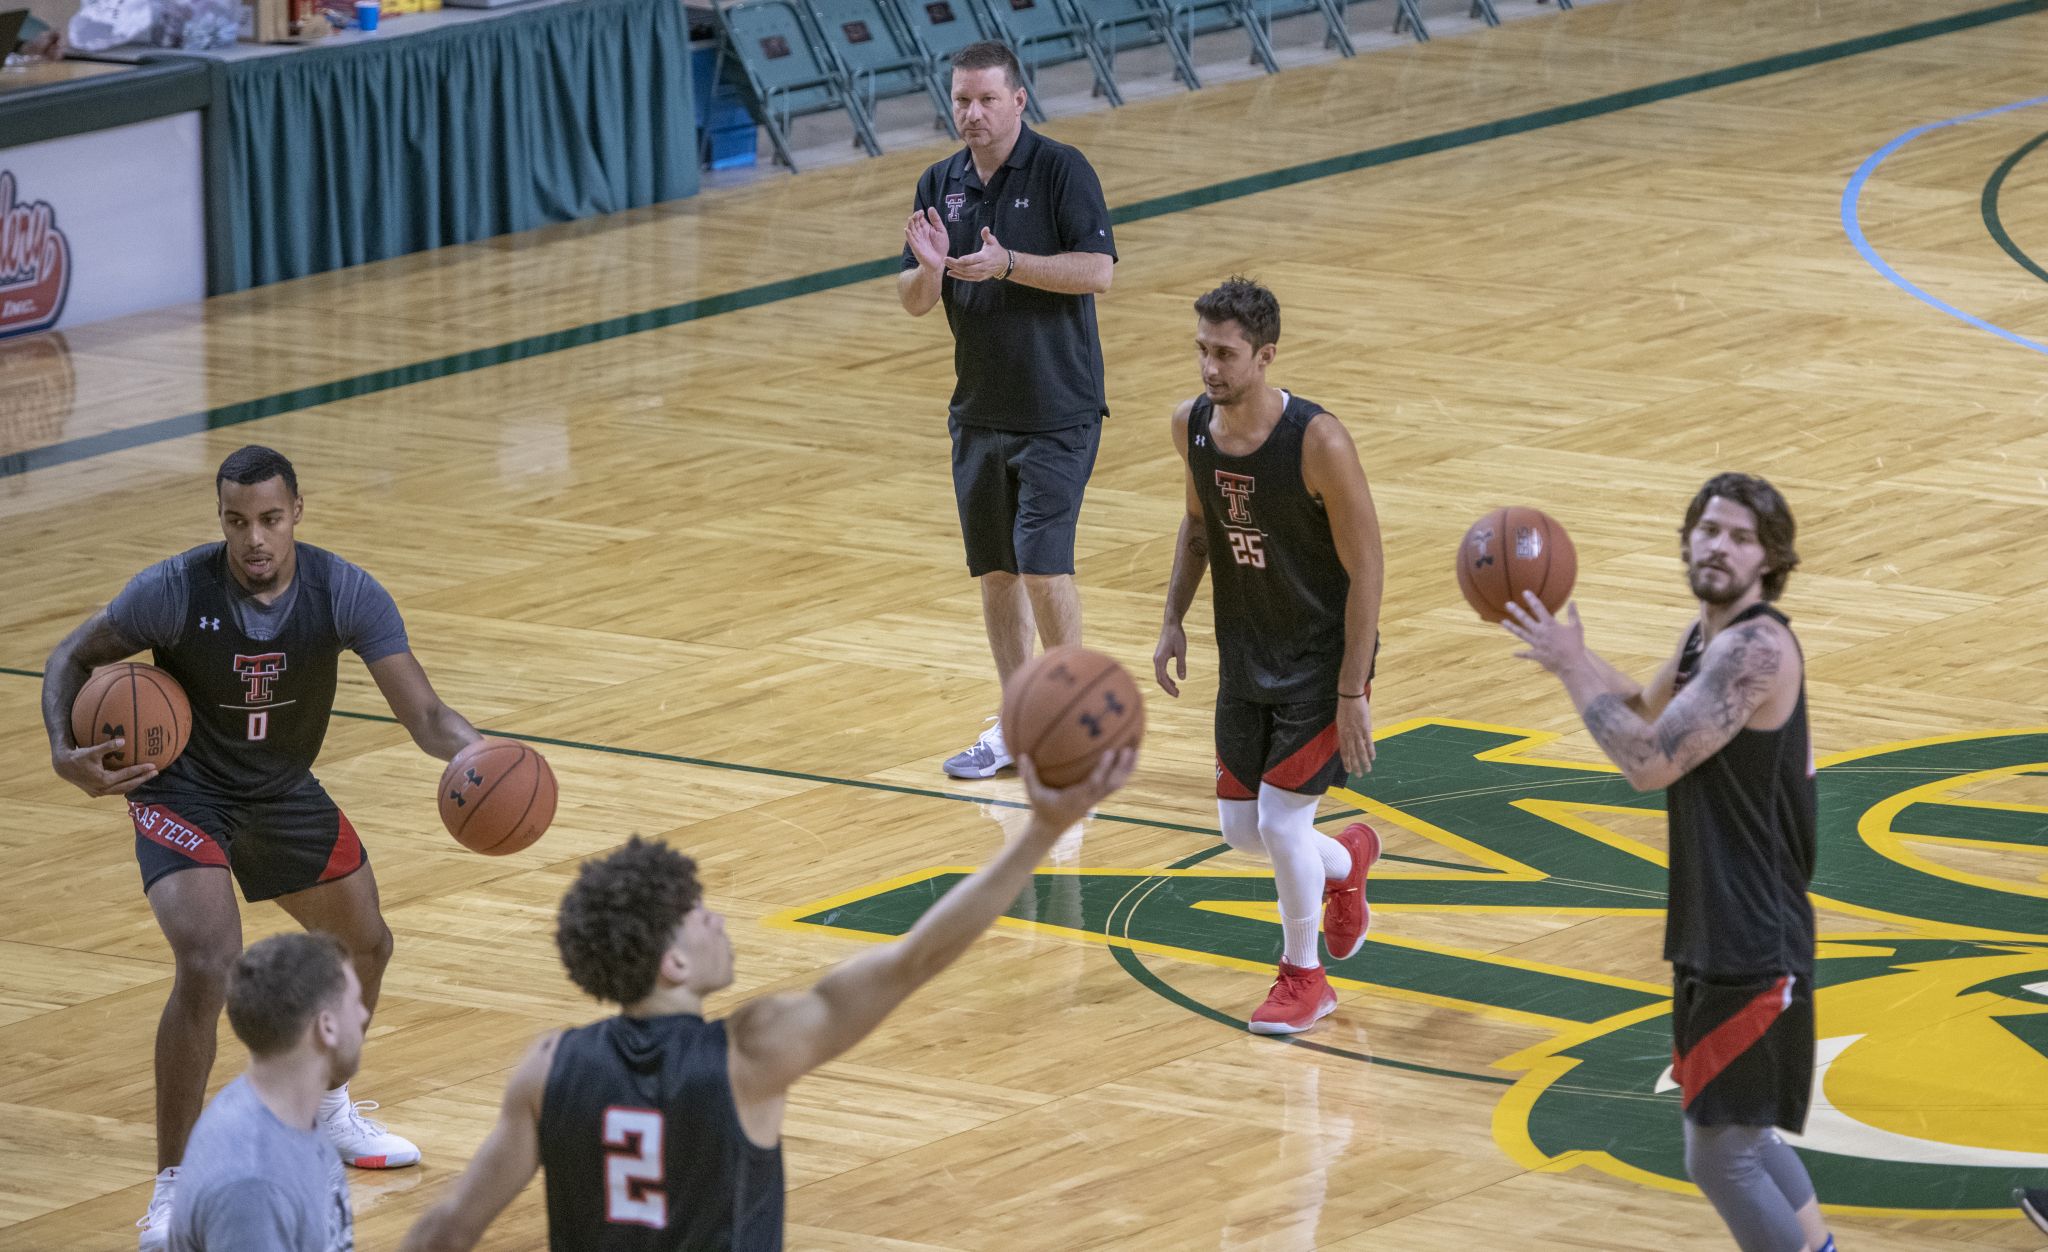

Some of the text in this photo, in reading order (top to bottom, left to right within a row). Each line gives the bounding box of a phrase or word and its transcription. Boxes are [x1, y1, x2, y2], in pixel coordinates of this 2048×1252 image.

[1228, 532, 1266, 569] 25
[157, 817, 204, 851] TECH
[603, 1105, 668, 1230] 2
